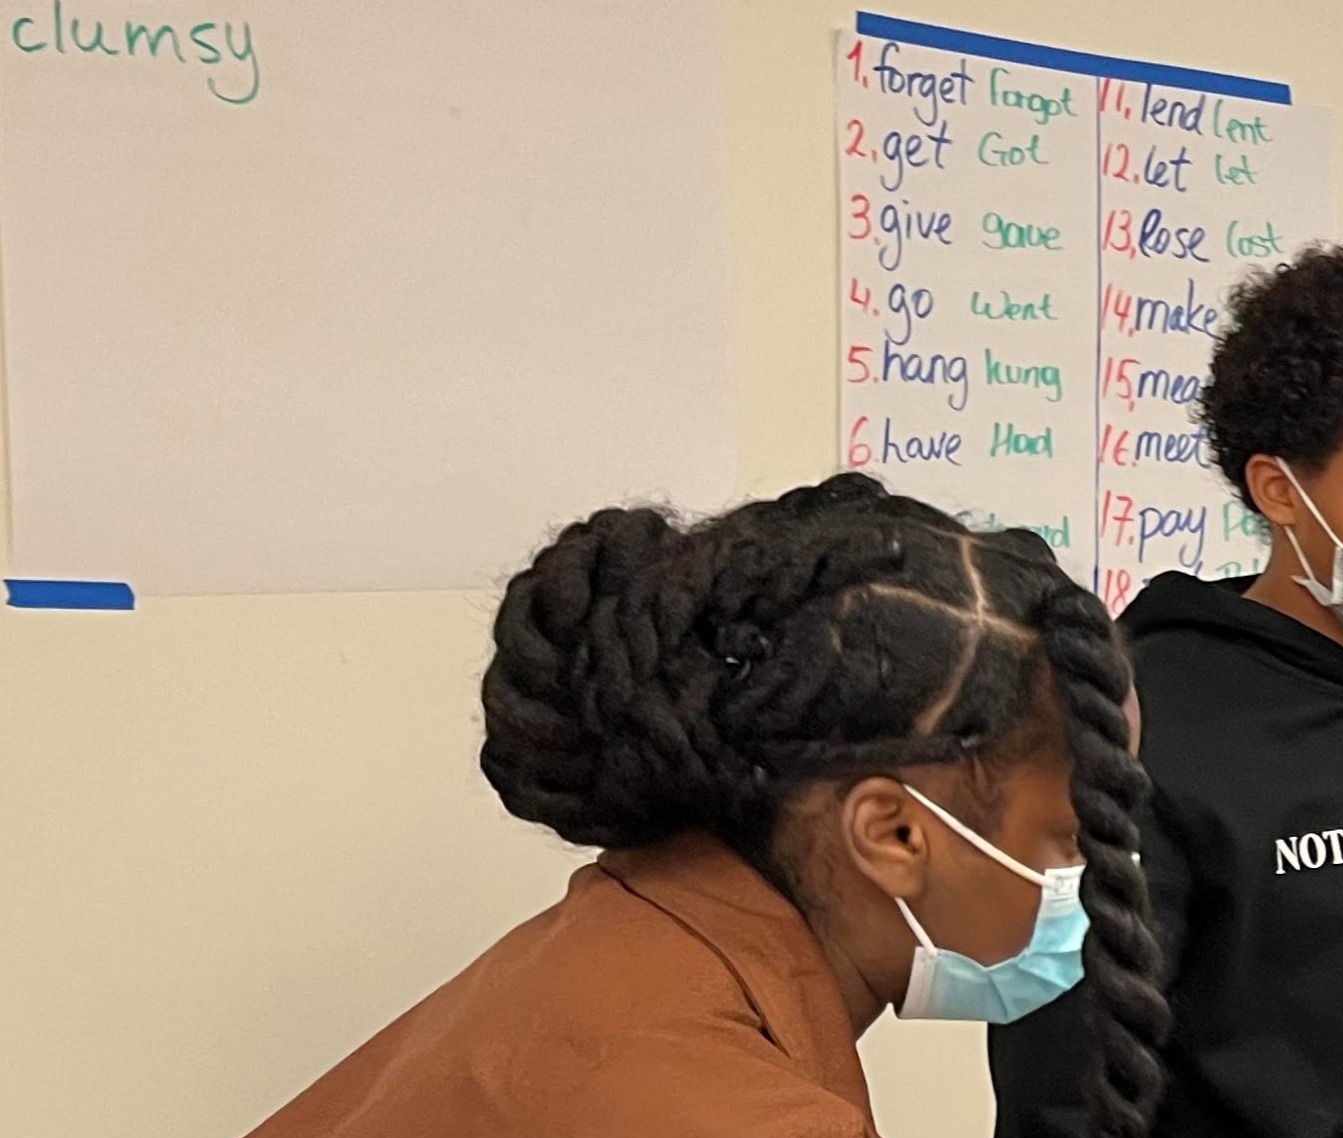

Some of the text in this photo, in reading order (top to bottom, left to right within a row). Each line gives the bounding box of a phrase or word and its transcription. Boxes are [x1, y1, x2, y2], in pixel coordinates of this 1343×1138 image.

[12, 0, 260, 104] clumsy
[873, 42, 975, 126] forget
[1142, 83, 1206, 136] lend
[879, 120, 953, 192] get
[1143, 145, 1193, 193] let
[878, 199, 952, 272] give
[1138, 208, 1211, 262] lose
[884, 283, 934, 346] go
[1135, 278, 1228, 344] make
[881, 339, 969, 412] hang
[881, 417, 963, 466] have
[1134, 426, 1213, 469] meet
[1138, 505, 1207, 569] pay
